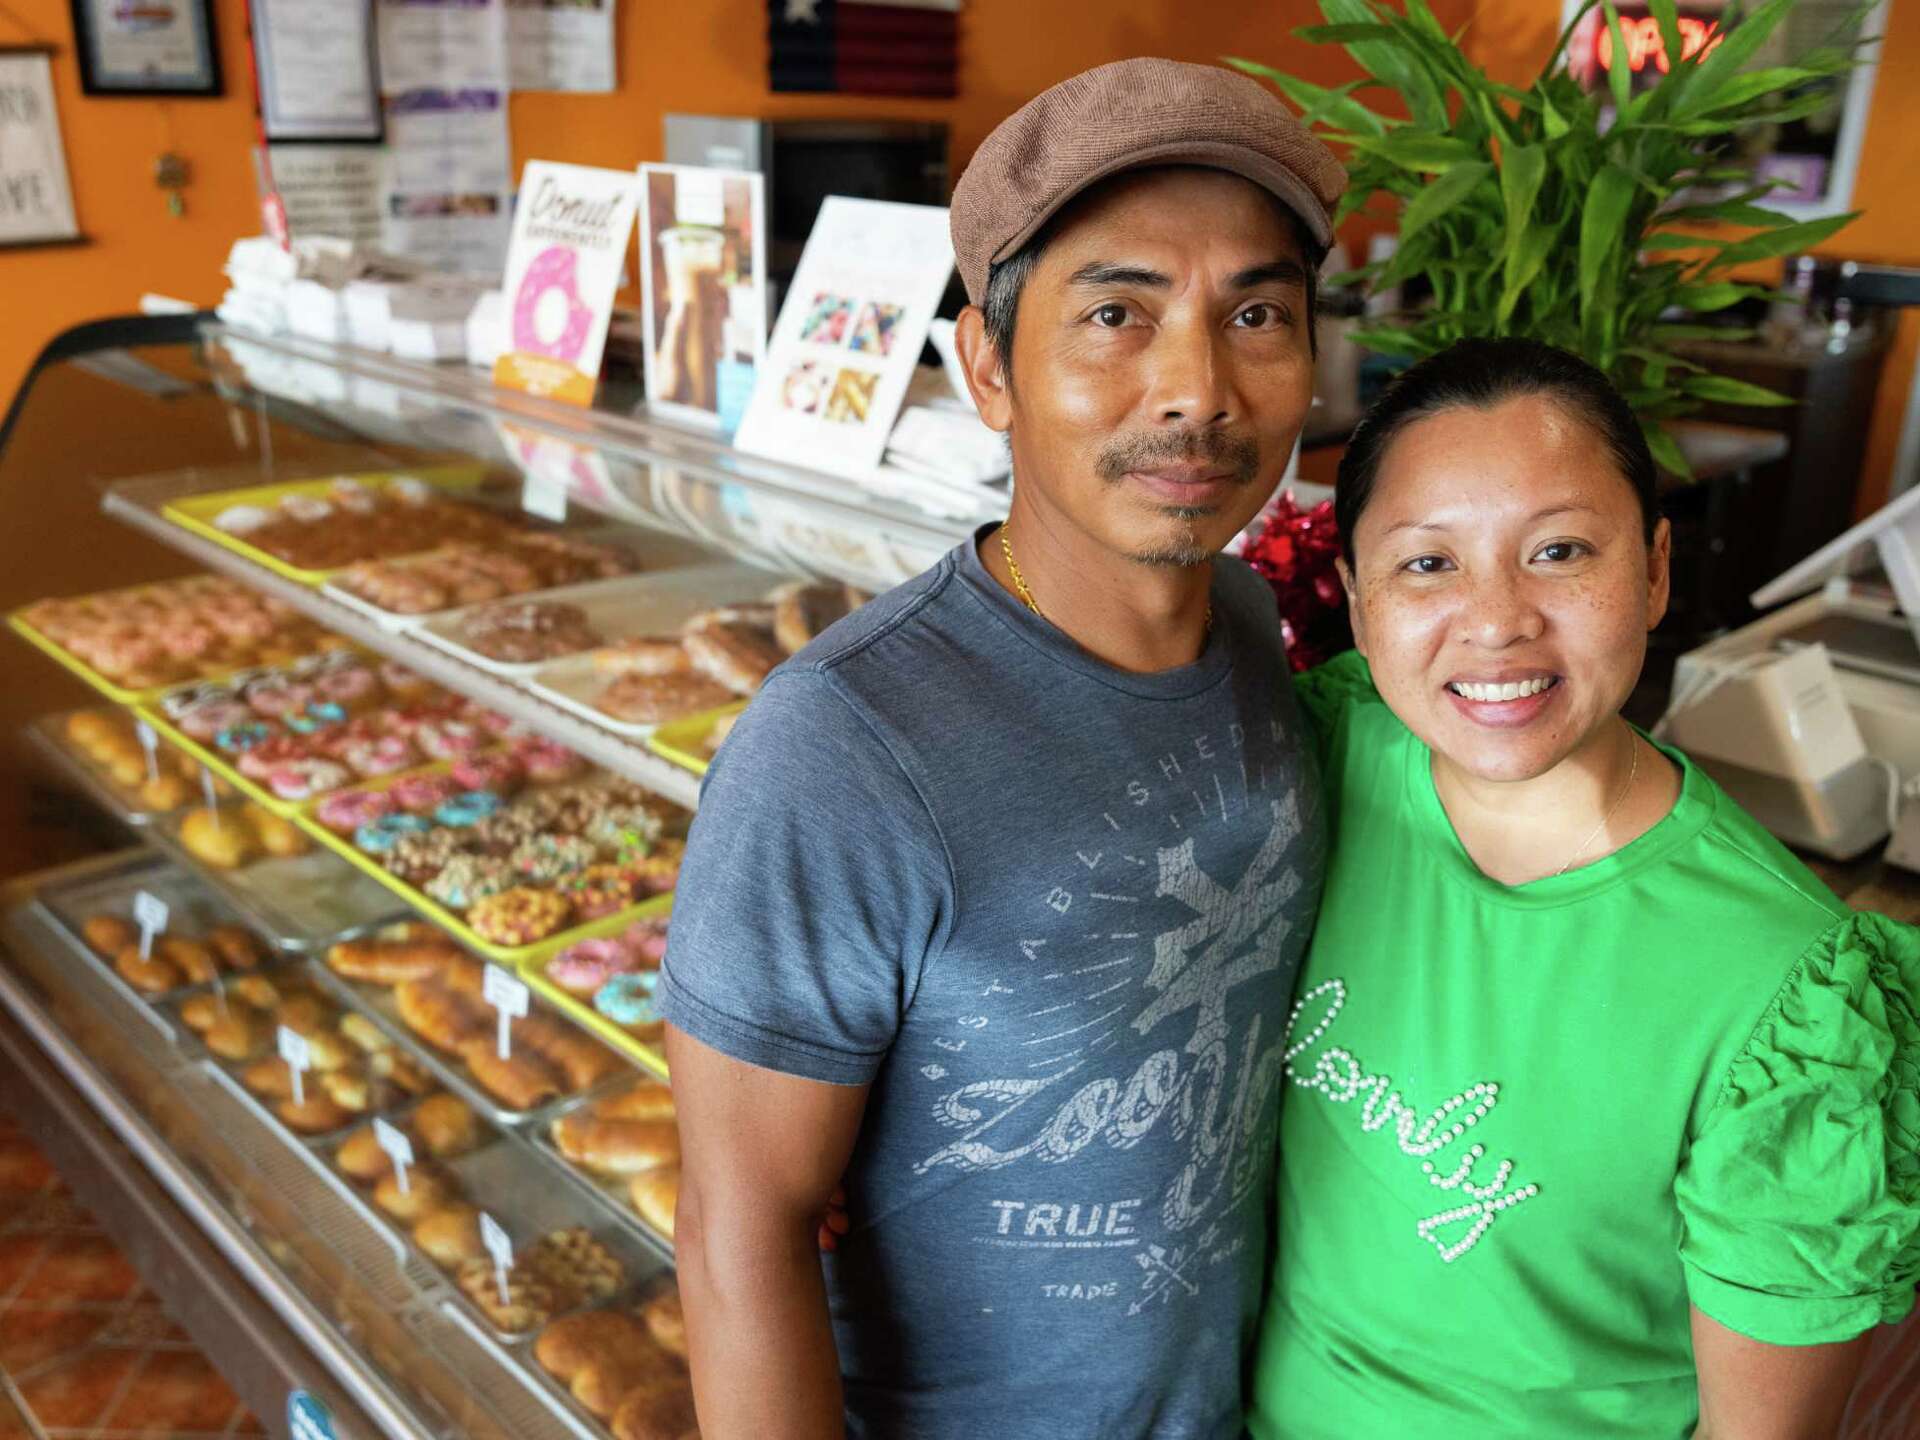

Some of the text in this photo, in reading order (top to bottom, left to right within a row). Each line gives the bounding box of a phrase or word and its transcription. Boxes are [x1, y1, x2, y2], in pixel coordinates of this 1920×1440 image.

[528, 176, 623, 228] Donut
[991, 1198, 1143, 1237] TRUE
[1040, 1282, 1119, 1301] TRADE
